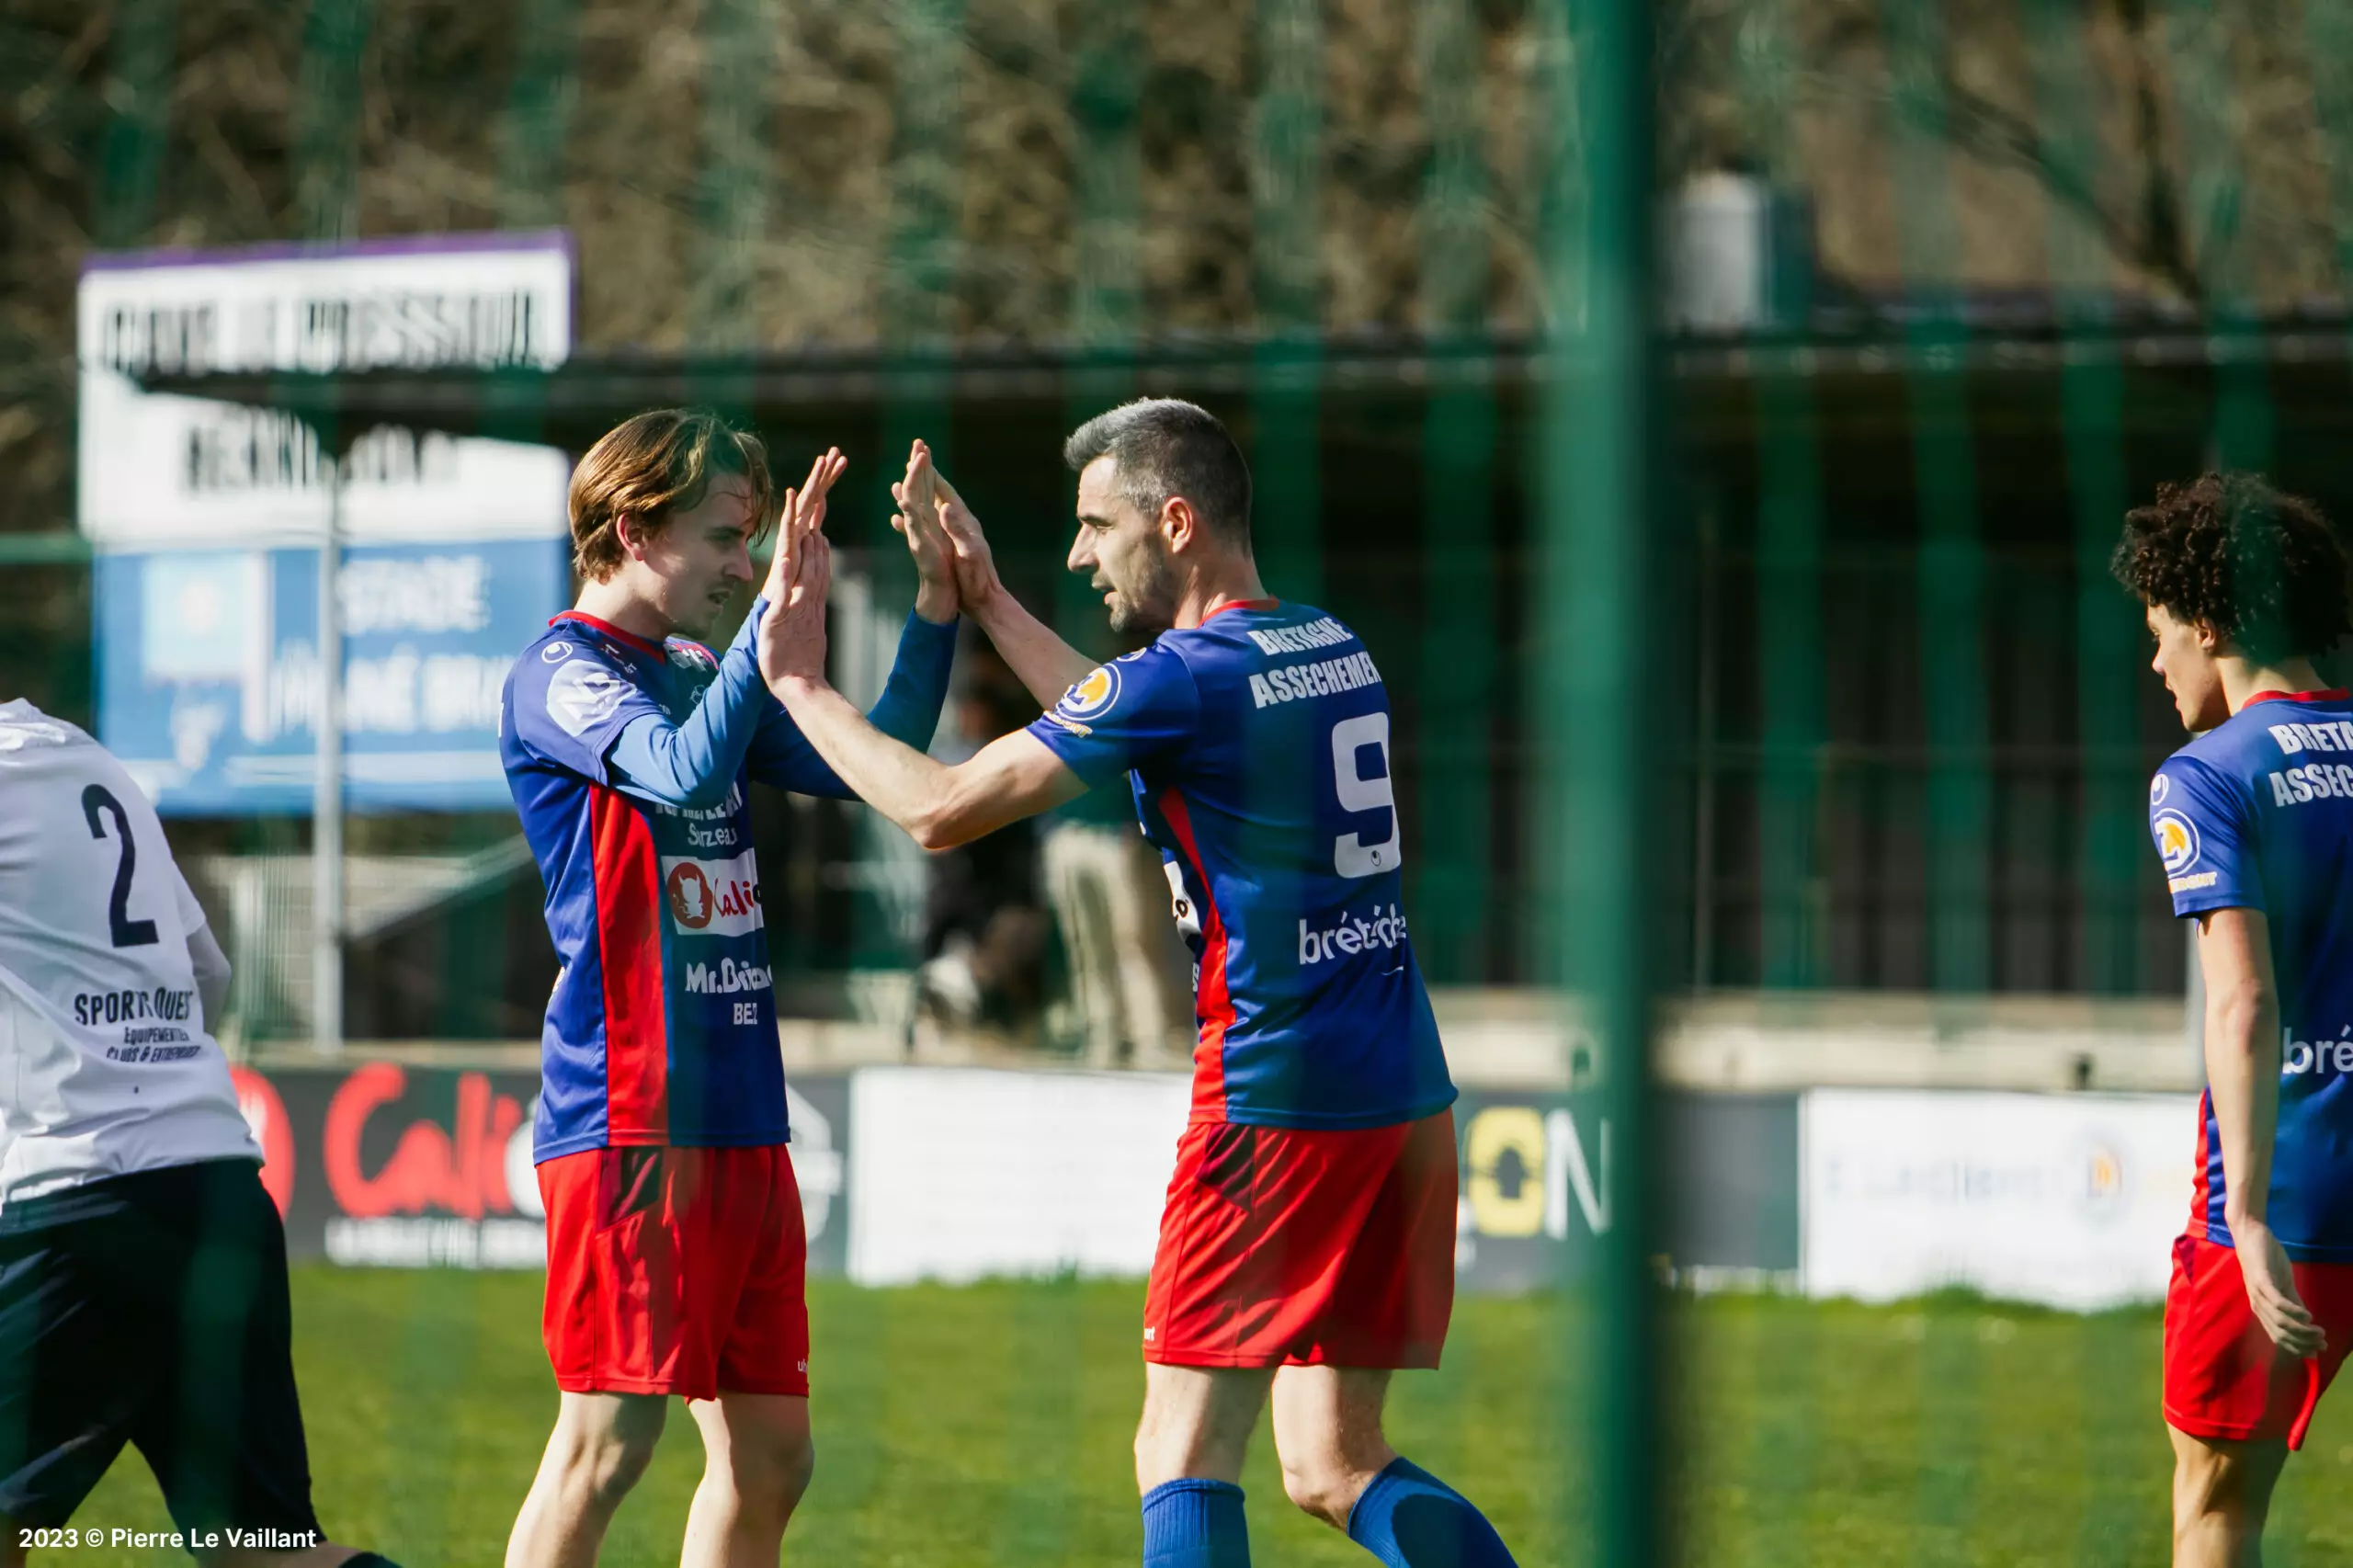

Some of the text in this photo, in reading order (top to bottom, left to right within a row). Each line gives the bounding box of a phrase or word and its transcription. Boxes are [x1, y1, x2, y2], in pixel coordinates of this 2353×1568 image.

[1246, 617, 1354, 656] BRETAGNE
[1332, 711, 1402, 879] 9
[81, 783, 159, 949] 2
[2281, 1023, 2353, 1074] bré
